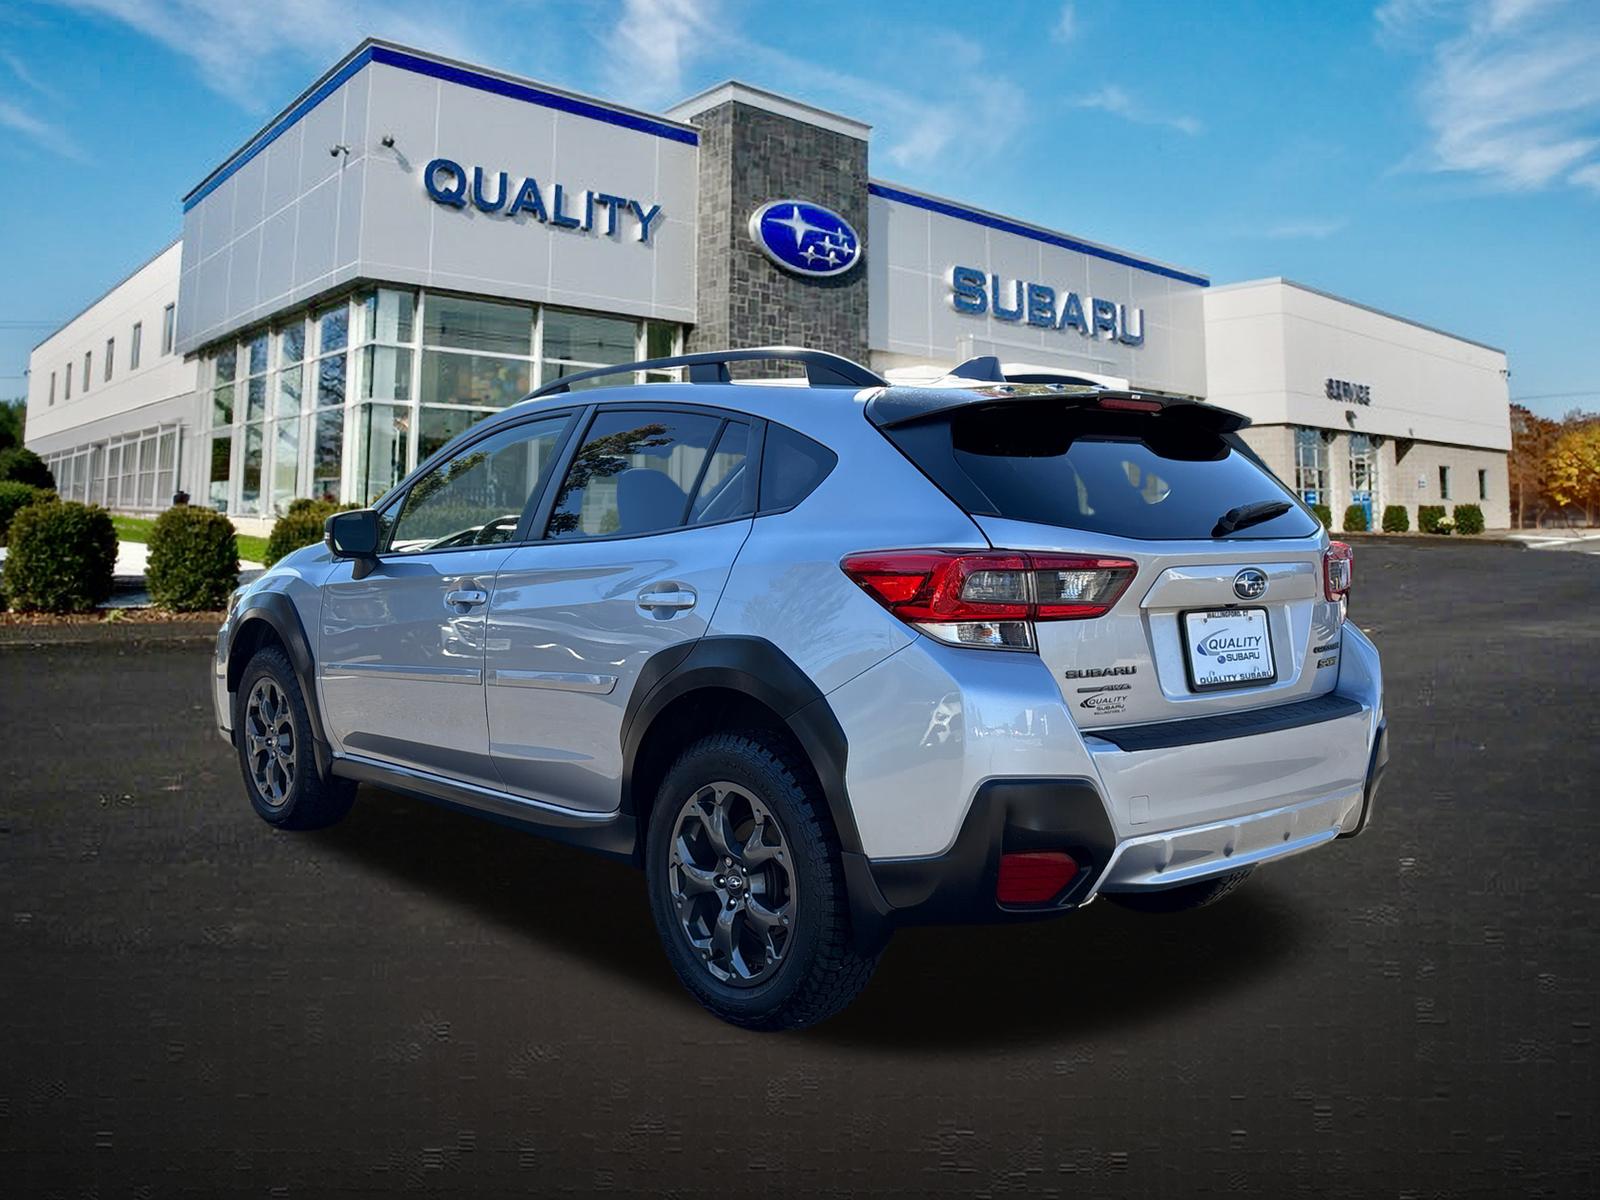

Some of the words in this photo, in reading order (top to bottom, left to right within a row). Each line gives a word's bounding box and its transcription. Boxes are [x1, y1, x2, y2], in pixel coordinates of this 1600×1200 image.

[424, 158, 661, 243] QUALITY
[951, 265, 1145, 346] SUBARU
[1324, 378, 1371, 406] SERVICE
[1208, 636, 1262, 650] QUALITY
[1226, 651, 1260, 662] SUBARU
[1065, 665, 1137, 679] SUBARU
[1200, 674, 1237, 684] QUALITY
[1239, 671, 1272, 681] SUBARU
[1089, 695, 1128, 705] QUALITY
